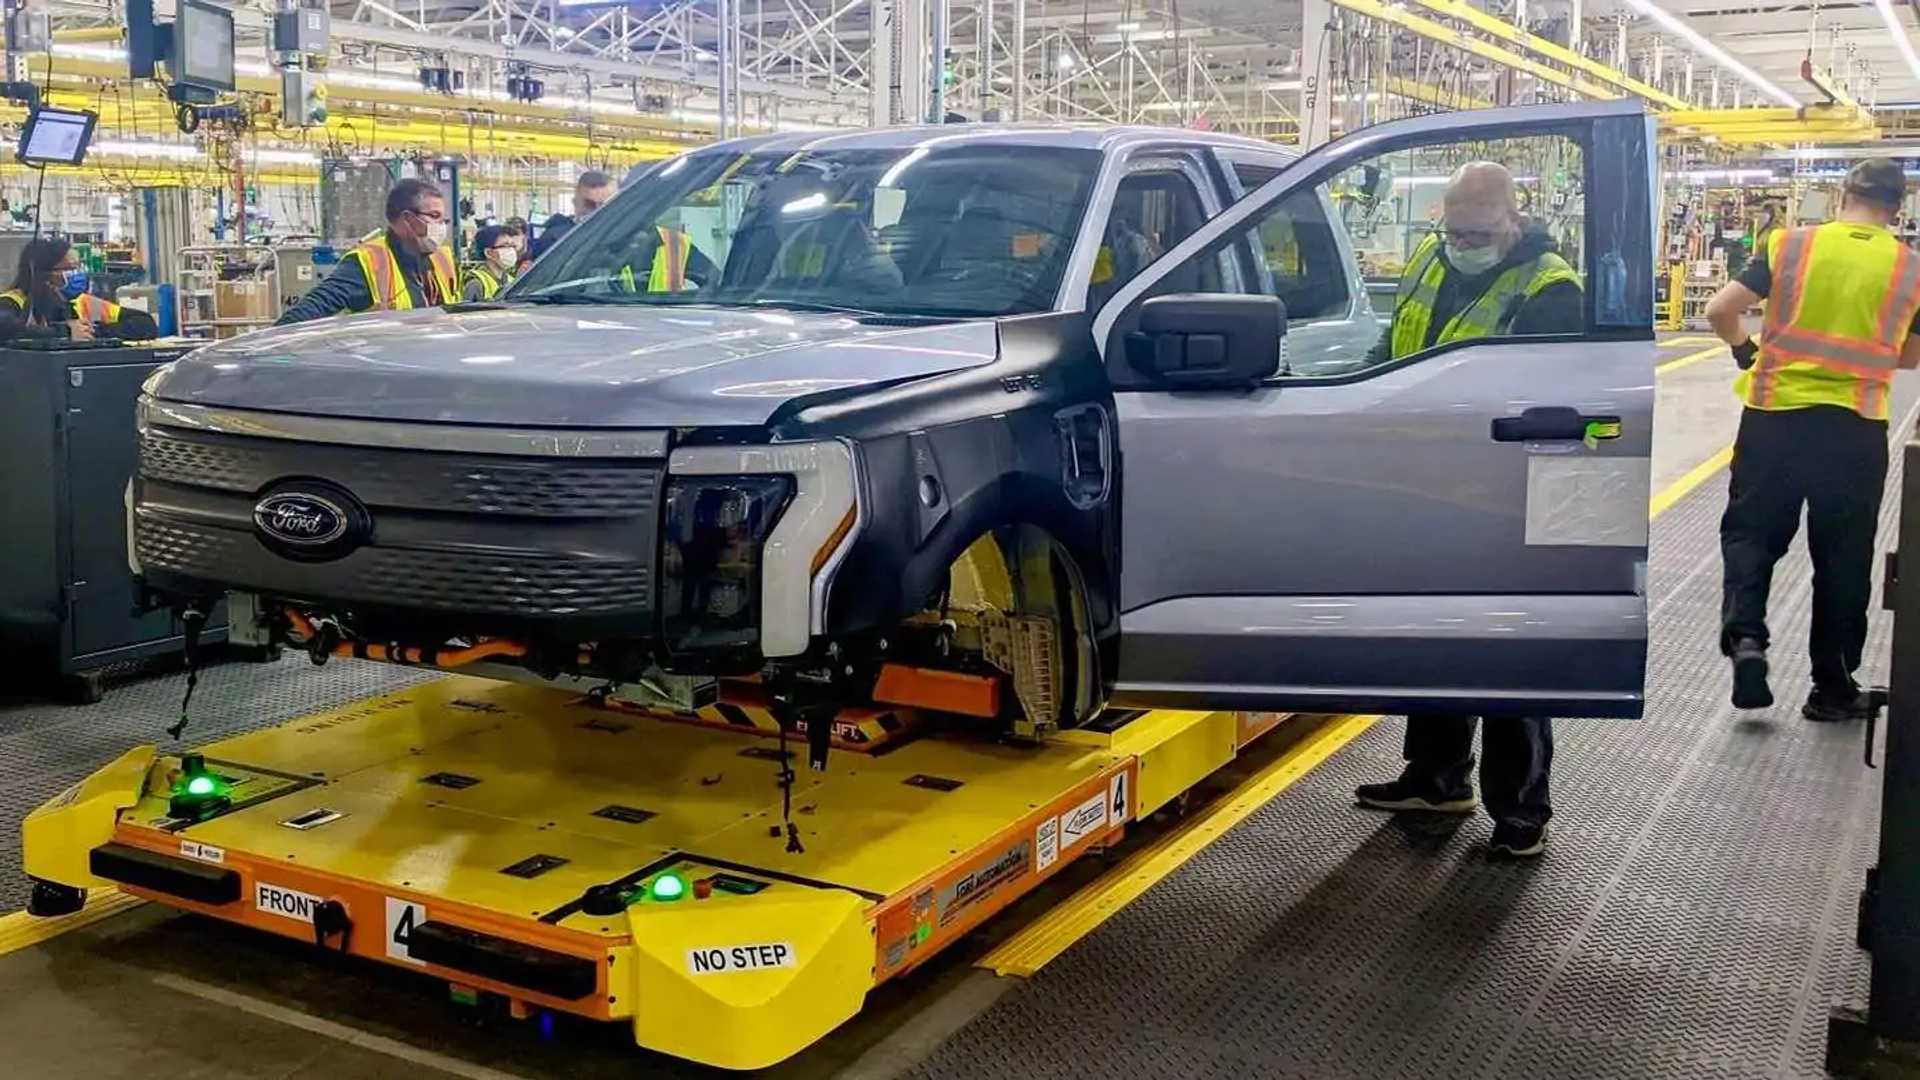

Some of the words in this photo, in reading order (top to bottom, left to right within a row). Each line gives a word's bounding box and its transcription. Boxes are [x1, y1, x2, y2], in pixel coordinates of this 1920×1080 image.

[272, 502, 322, 534] Ford
[1113, 774, 1125, 817] 4
[393, 904, 416, 957] 4
[692, 948, 727, 972] NO
[731, 944, 787, 969] STEP
